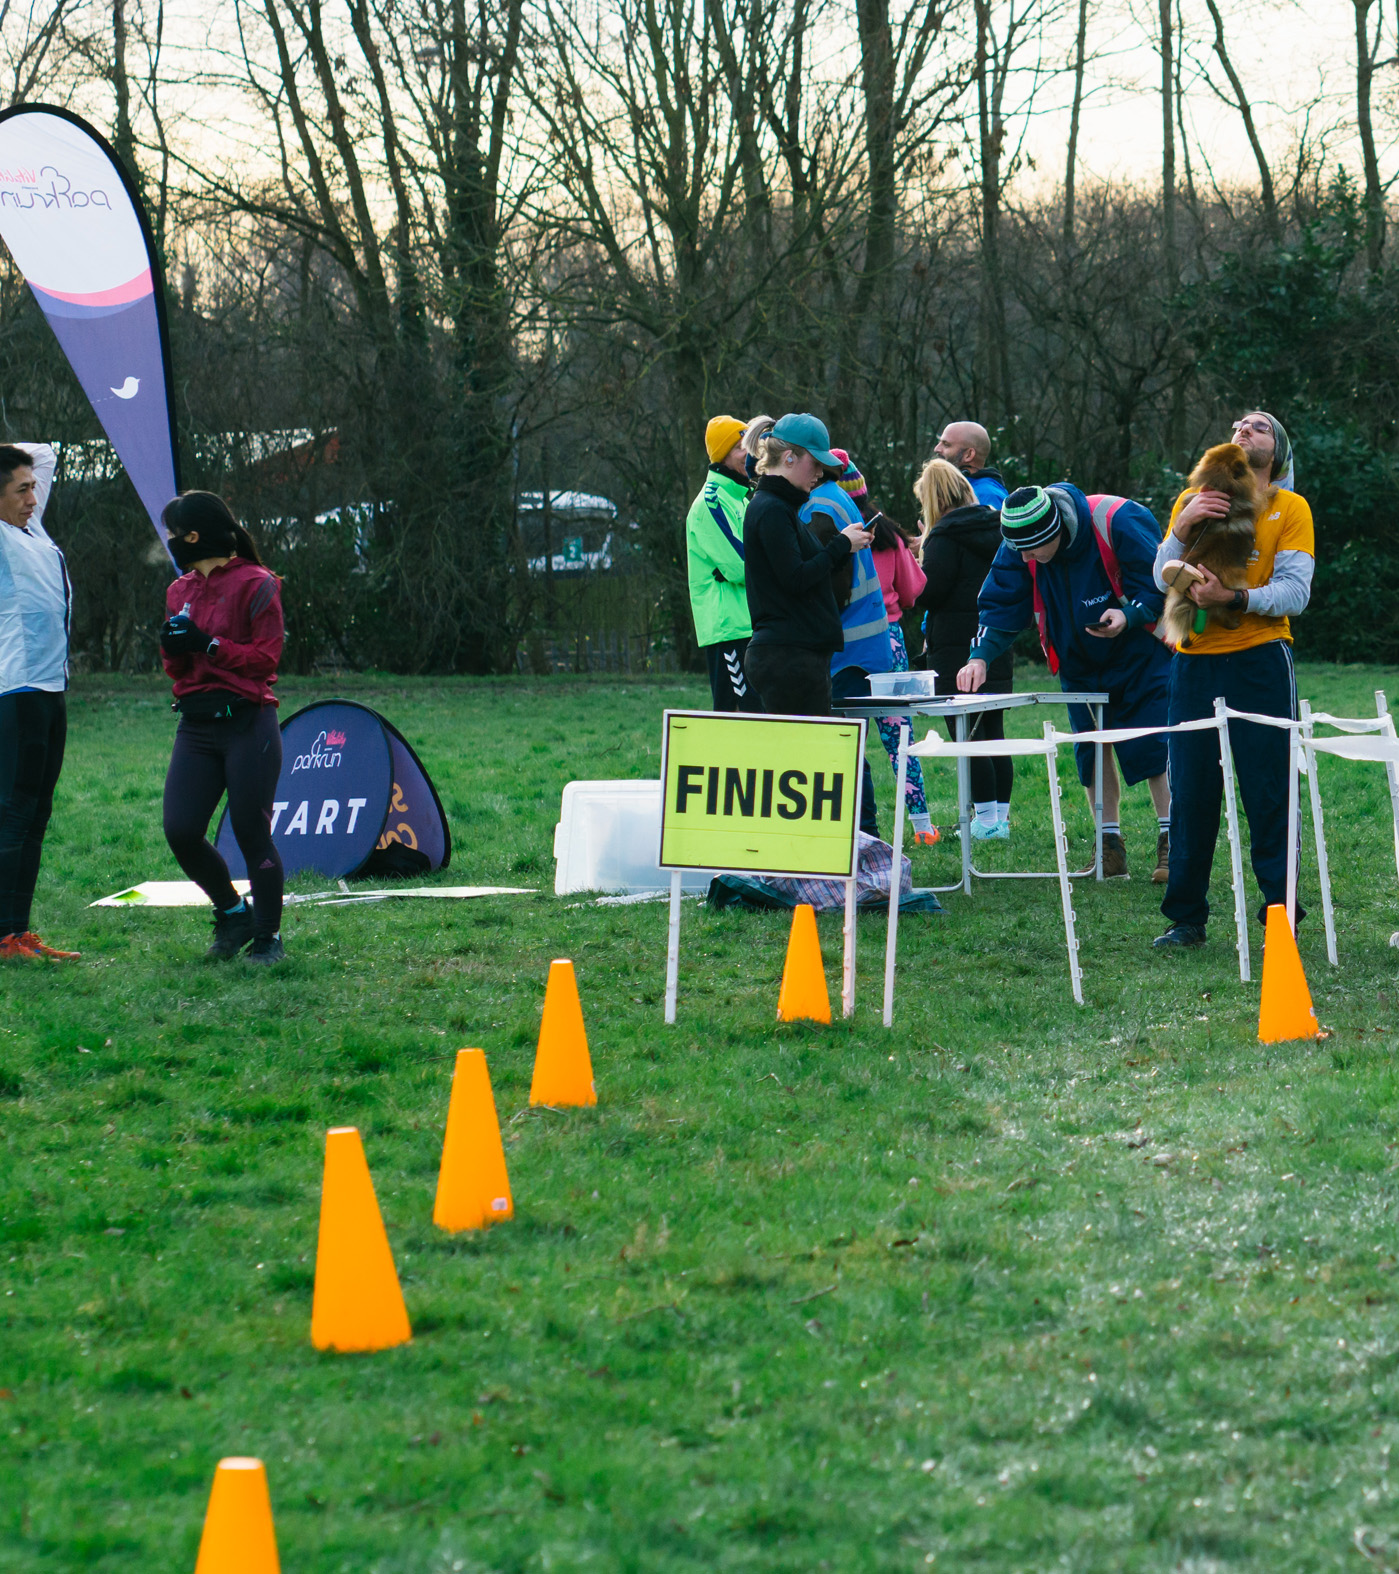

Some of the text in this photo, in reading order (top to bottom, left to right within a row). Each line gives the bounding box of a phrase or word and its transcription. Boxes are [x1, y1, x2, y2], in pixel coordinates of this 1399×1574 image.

[291, 735, 342, 774] parkrun
[676, 765, 844, 821] FINISH
[270, 798, 367, 836] TART
